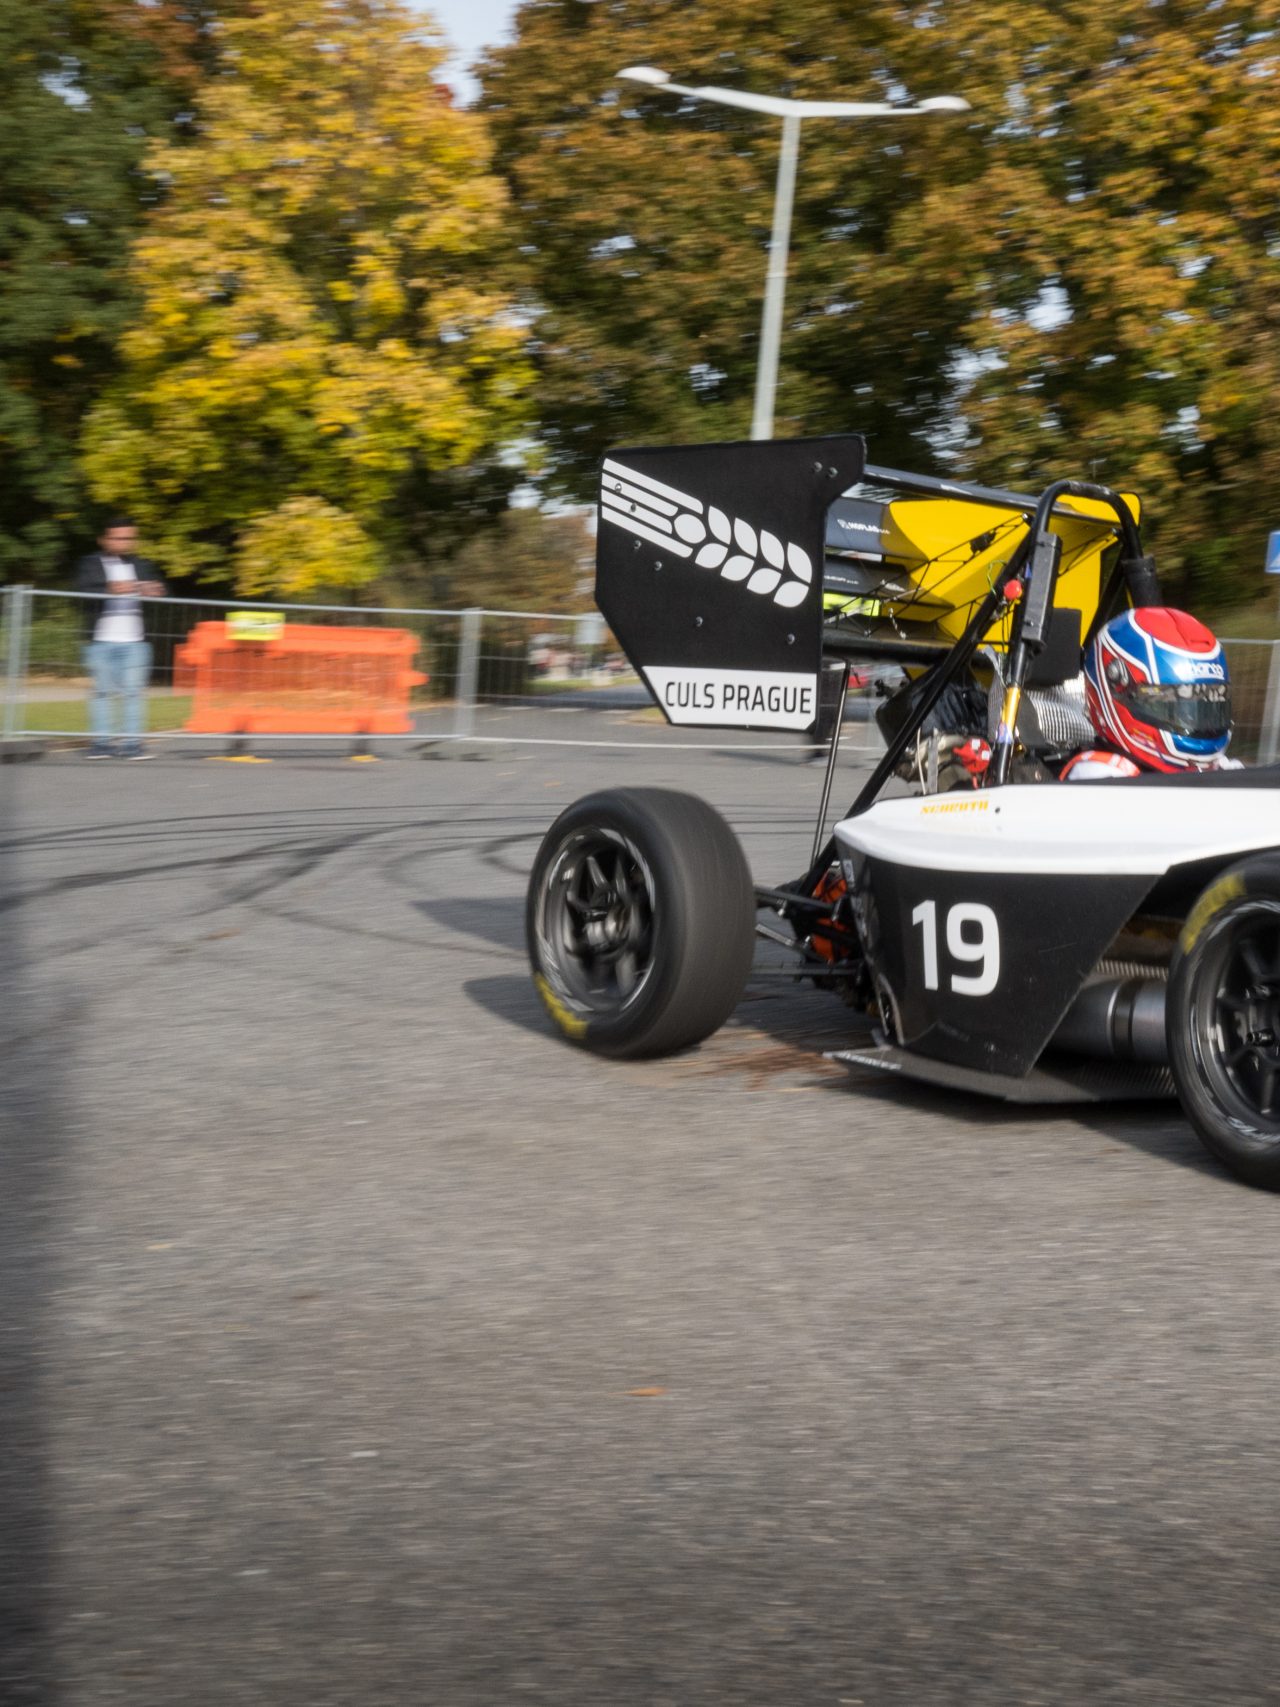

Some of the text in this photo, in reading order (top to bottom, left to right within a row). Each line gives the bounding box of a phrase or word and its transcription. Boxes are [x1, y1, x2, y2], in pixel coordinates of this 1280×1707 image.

[665, 682, 812, 714] CULS PRAGUE
[912, 899, 1000, 996] 19
